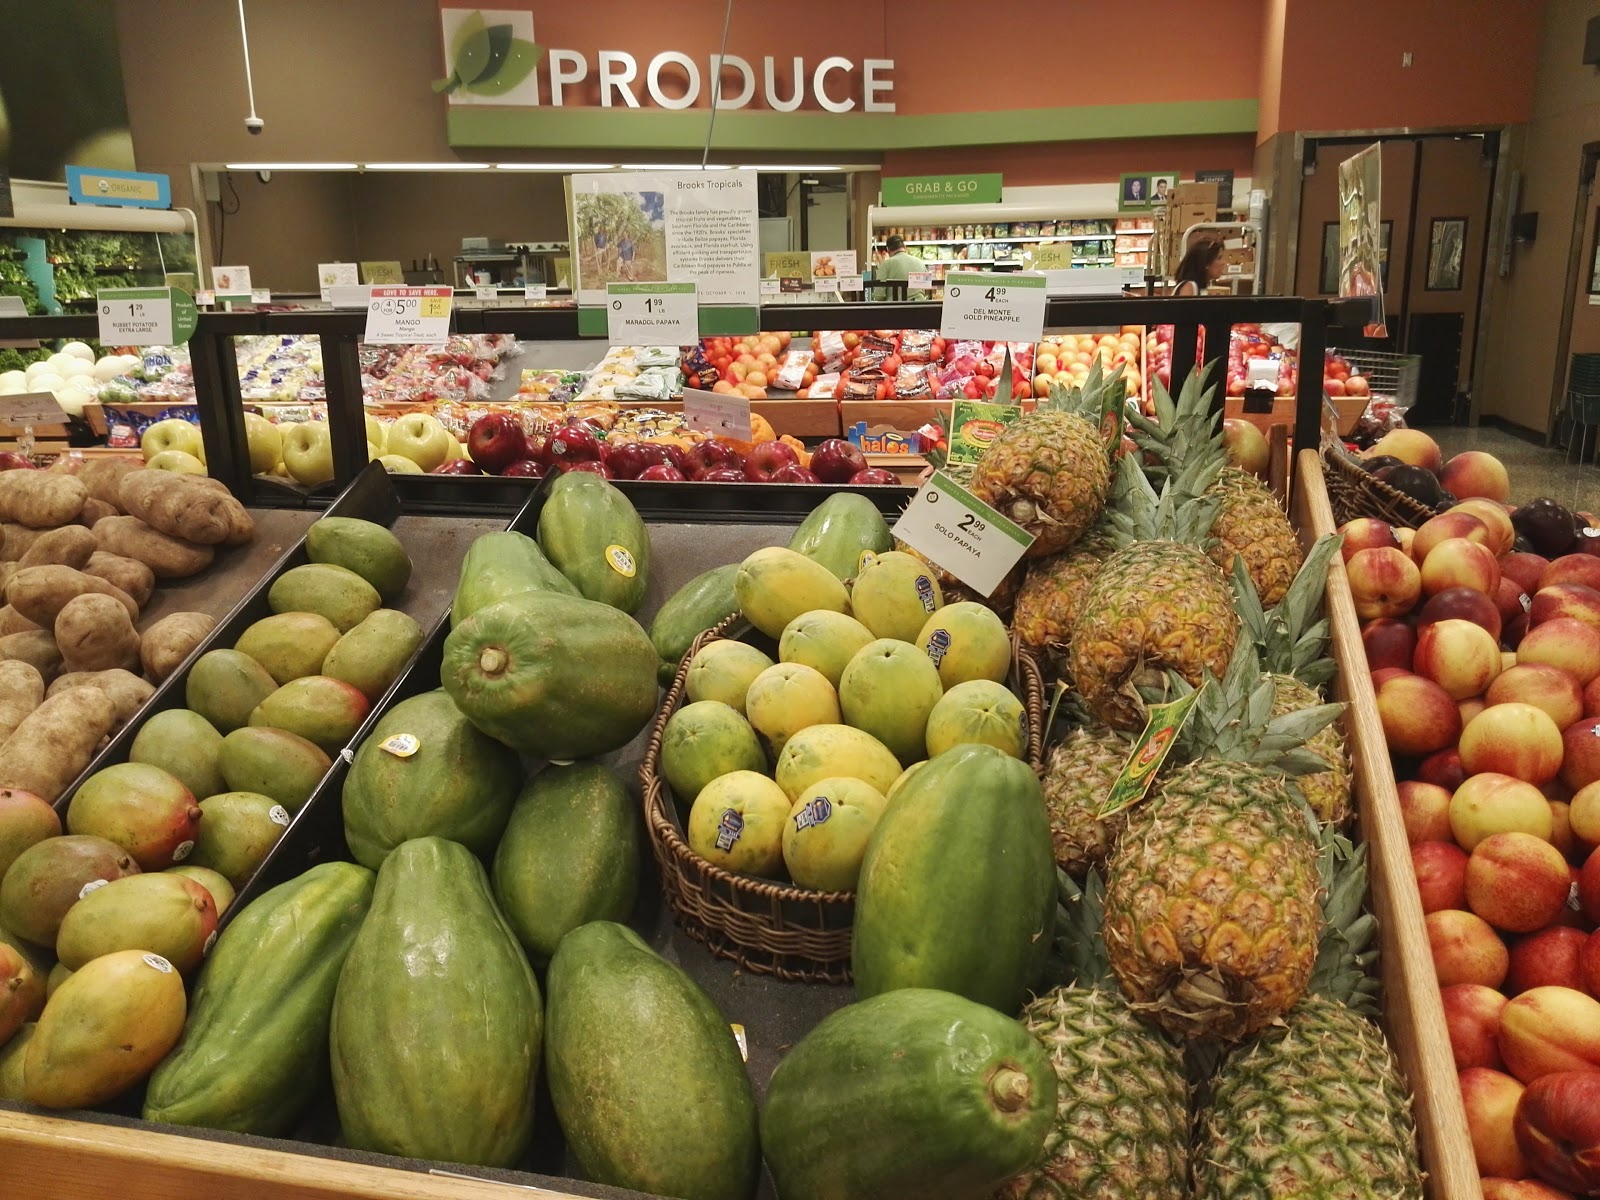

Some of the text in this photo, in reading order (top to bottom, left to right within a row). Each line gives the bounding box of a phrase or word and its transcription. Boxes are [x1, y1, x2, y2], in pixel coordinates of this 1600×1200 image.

[549, 49, 897, 113] PRODUCE
[111, 184, 141, 193] ORGANIC
[678, 179, 743, 190] Brooks Tropicals
[906, 180, 977, 193] GRAB & GO
[770, 259, 800, 268] FRESH
[860, 434, 909, 454] halos
[934, 523, 981, 559] SOLO PAPAYA
[967, 530, 982, 542] EACH
